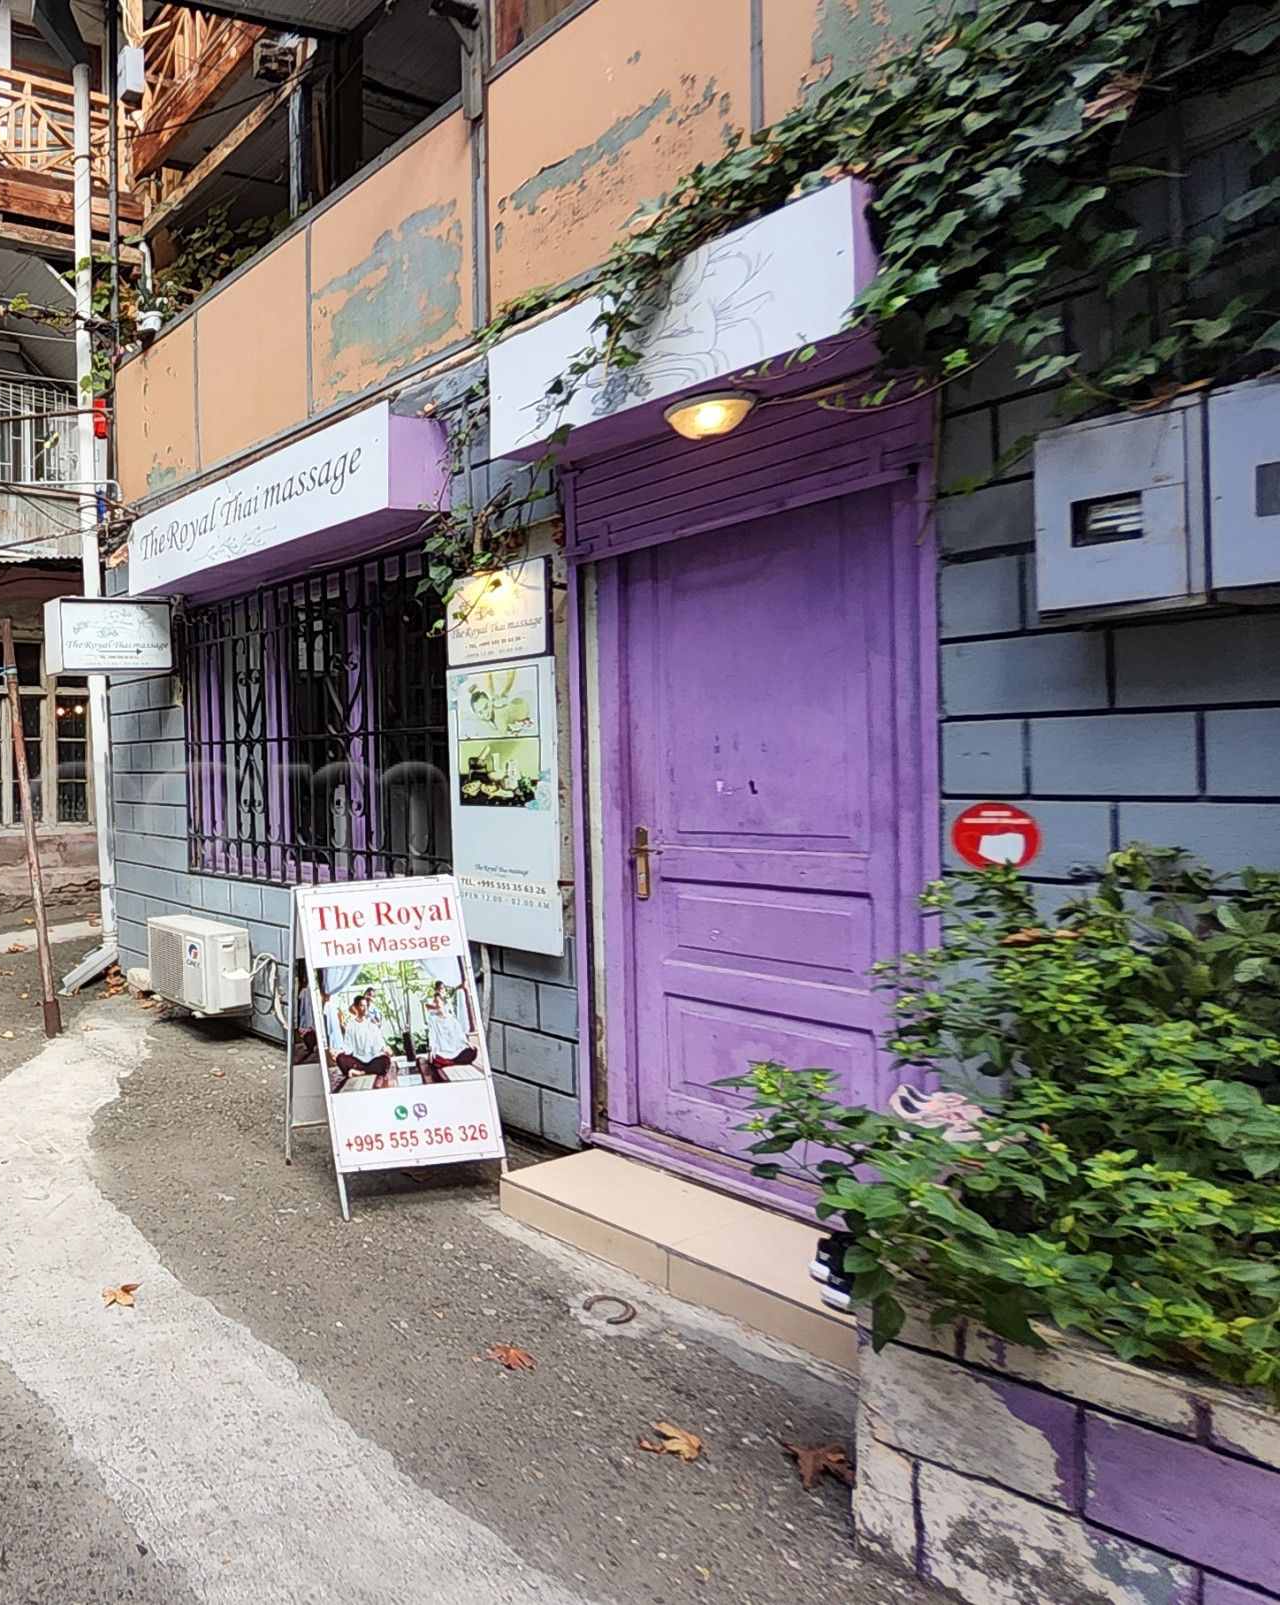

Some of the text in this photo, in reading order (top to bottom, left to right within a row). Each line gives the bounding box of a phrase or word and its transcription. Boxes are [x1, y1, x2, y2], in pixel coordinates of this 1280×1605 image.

[140, 446, 363, 561] The Royal Thai massage
[65, 640, 169, 651] The Royal Thai massage
[460, 877, 546, 895] TEL. +995 555 35 63 26
[460, 891, 478, 899] OPEN
[537, 901, 550, 909] AM
[312, 896, 454, 931] The Royal
[320, 934, 452, 957] Thai Massage
[345, 1123, 489, 1152] +995 555 356 326
